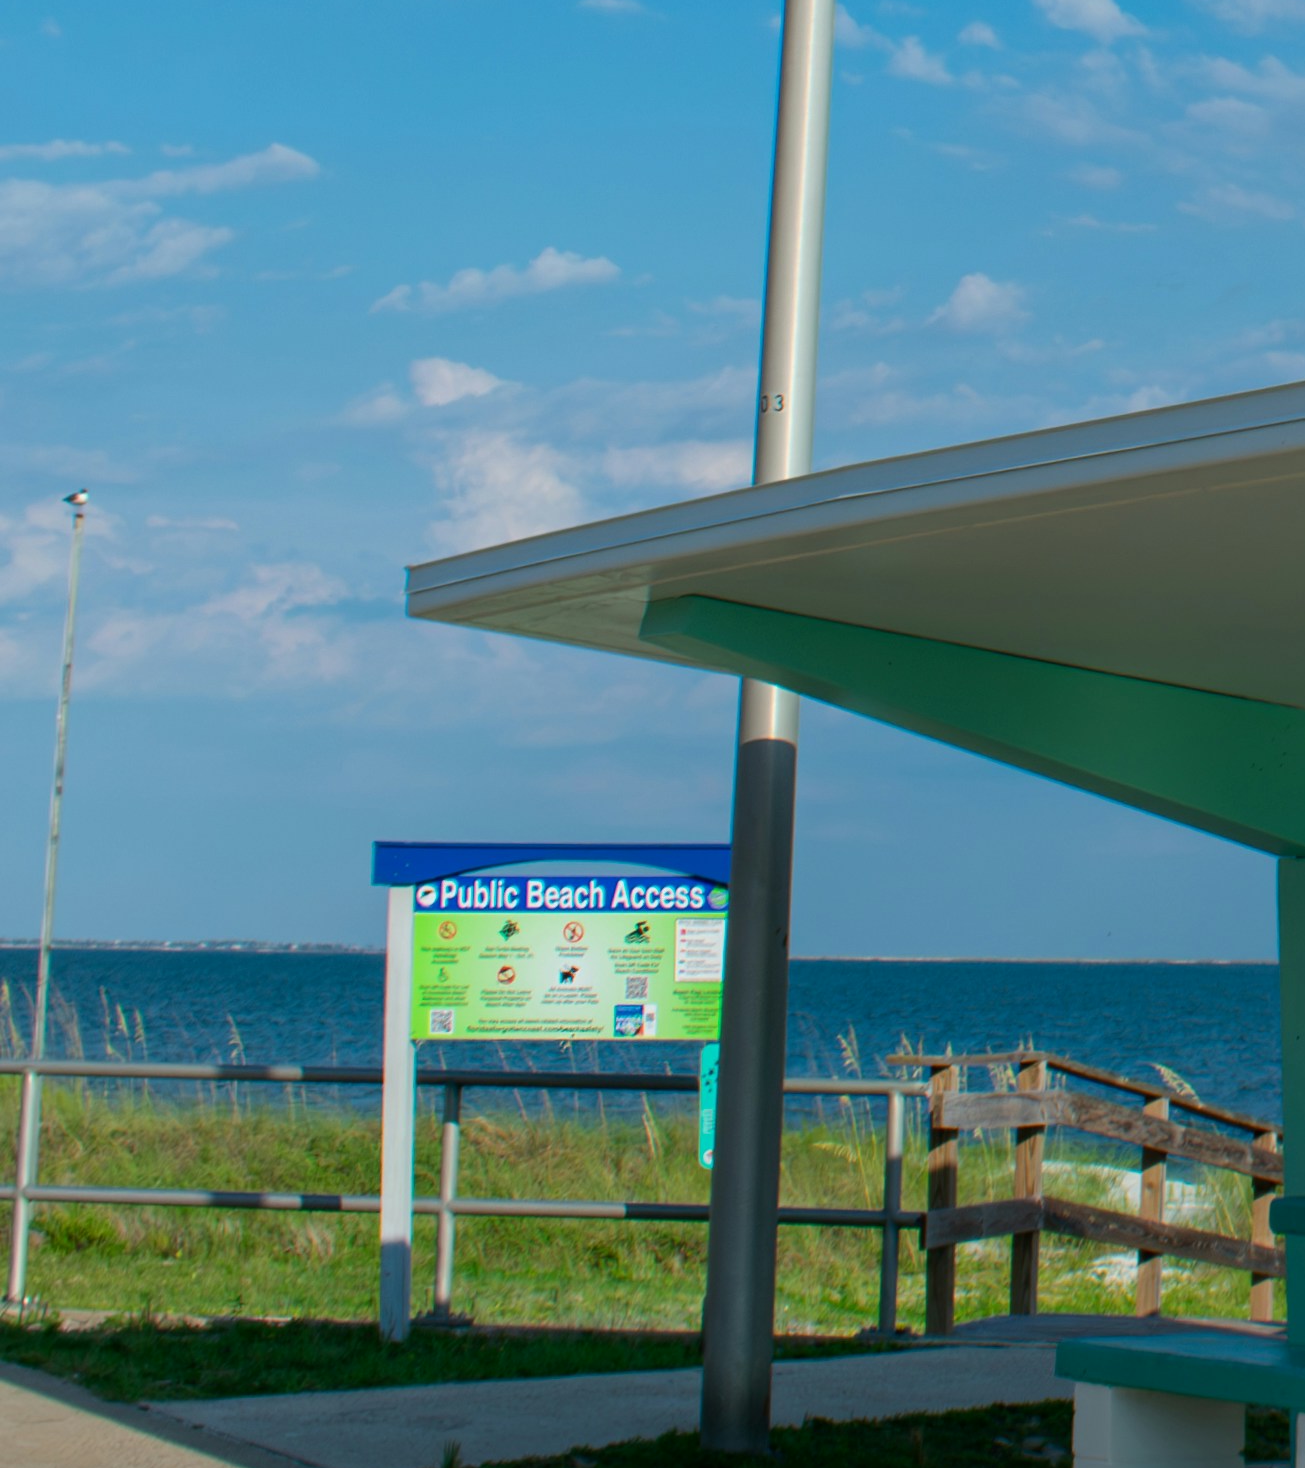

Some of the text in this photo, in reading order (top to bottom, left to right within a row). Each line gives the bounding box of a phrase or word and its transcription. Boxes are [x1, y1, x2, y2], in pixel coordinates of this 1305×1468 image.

[440, 879, 704, 909] Public Beach Access
